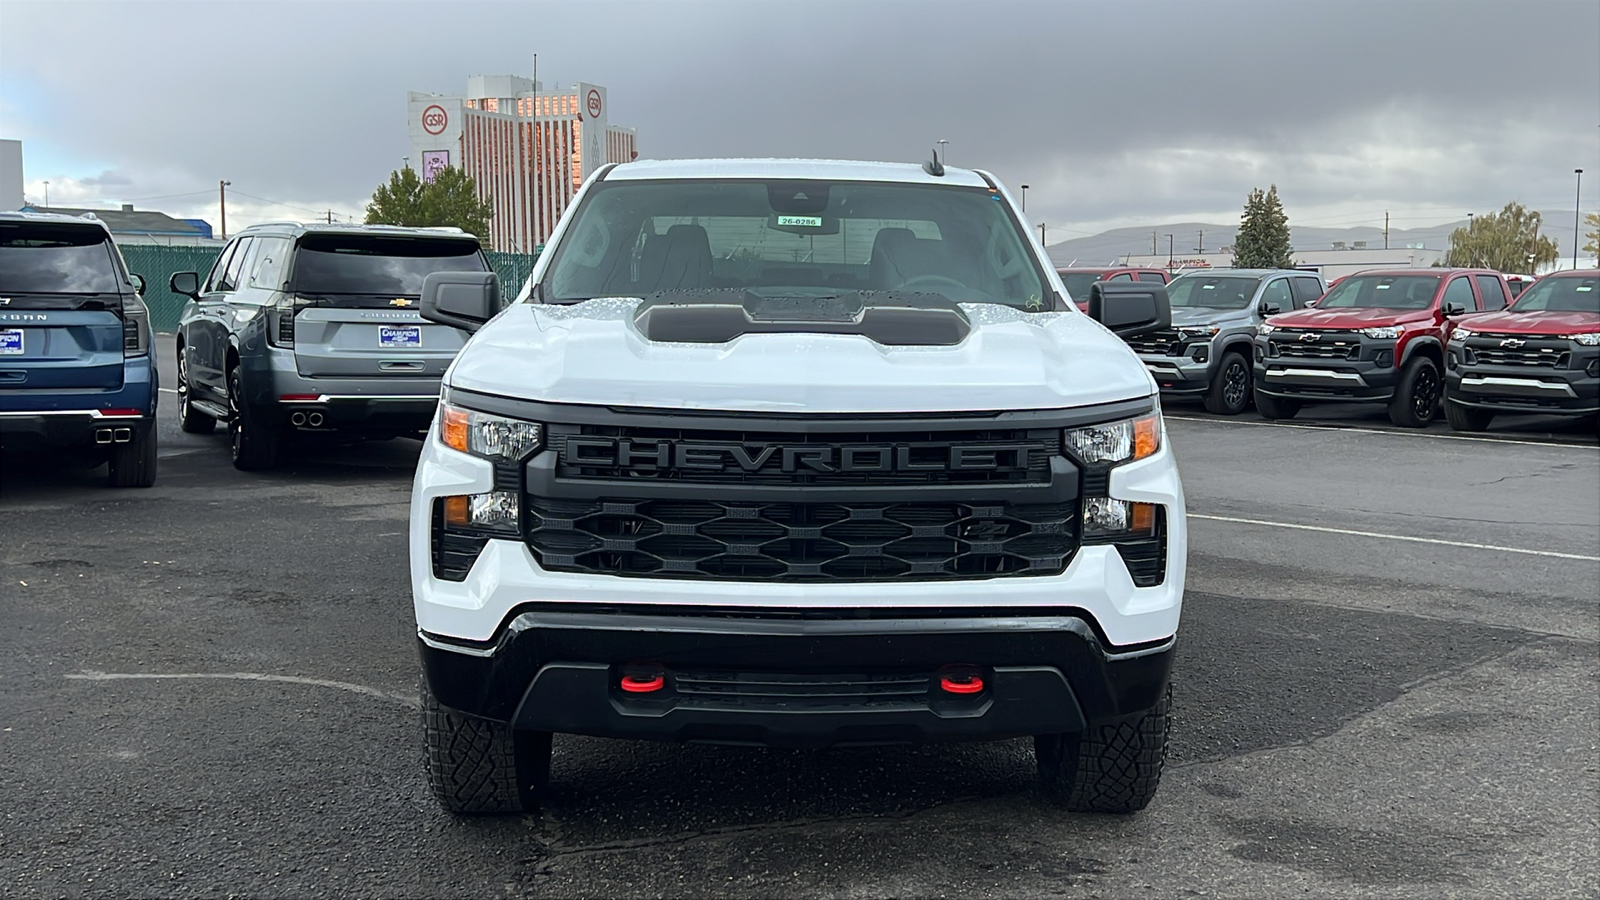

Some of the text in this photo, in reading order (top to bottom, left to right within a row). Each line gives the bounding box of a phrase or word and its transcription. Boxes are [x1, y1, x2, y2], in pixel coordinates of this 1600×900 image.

[590, 97, 599, 110] GSR
[425, 113, 444, 127] GSR
[783, 218, 815, 226] 26-0286
[382, 329, 418, 337] CHAMPION
[566, 437, 1045, 471] CHEVROLET
